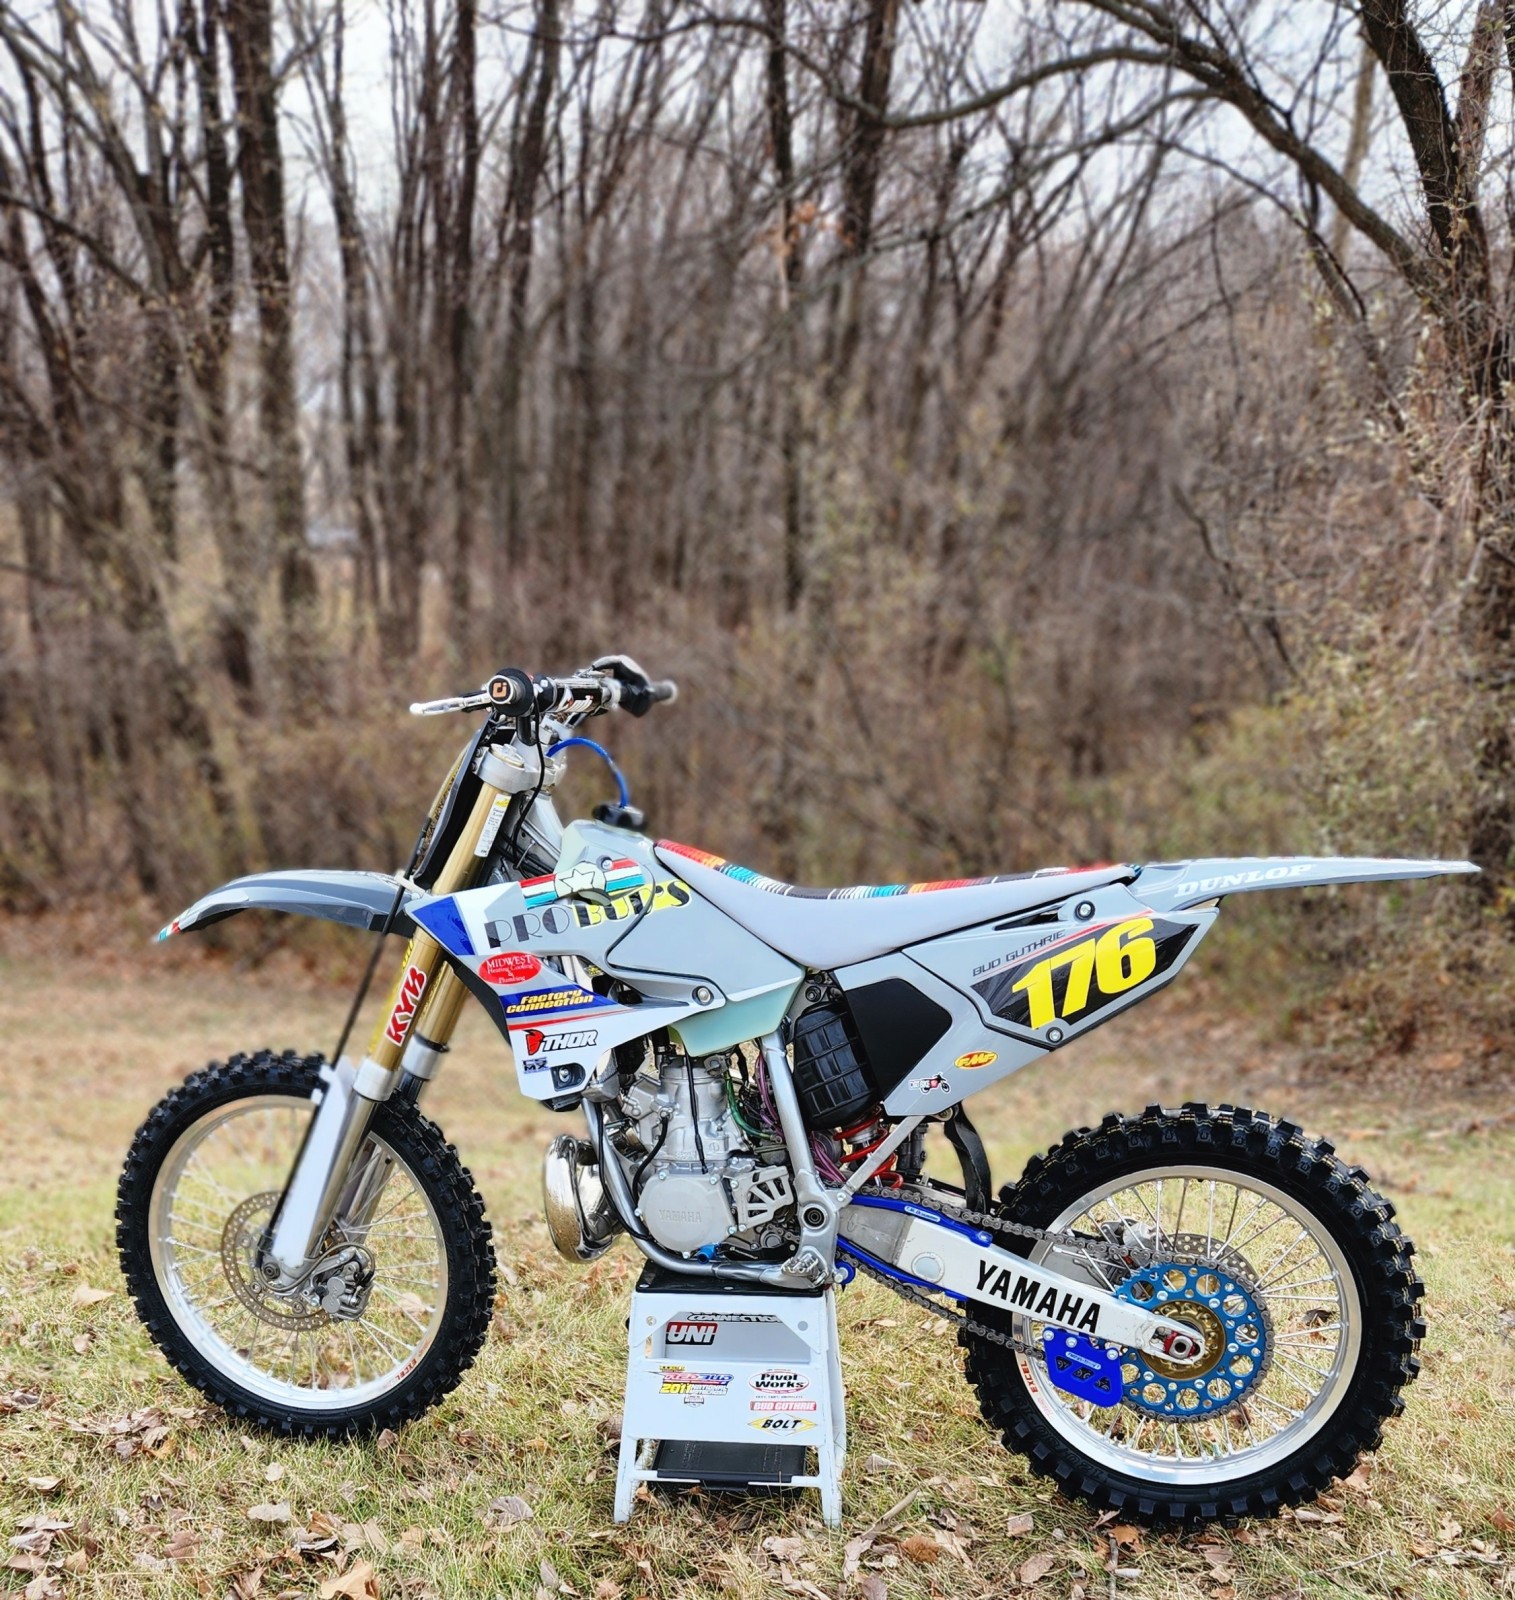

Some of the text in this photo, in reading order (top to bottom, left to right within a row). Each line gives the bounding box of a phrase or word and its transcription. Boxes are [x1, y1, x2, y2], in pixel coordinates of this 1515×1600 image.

[1174, 864, 1315, 898] DUNLOP
[486, 955, 531, 968] MIDWEST
[973, 929, 1066, 977] BUD GUTHRIE
[1012, 918, 1157, 1031] 176
[385, 966, 427, 1046] KYB
[542, 1030, 598, 1052] THOR
[658, 1209, 702, 1223] YAMAHA
[976, 1259, 1101, 1334] YAMAHA
[667, 1325, 716, 1343] UNI
[395, 1358, 417, 1380] EXCEL
[761, 1373, 798, 1381] Pivot
[1020, 1360, 1039, 1393] EXCEL
[660, 1383, 692, 1394] 2011
[754, 1402, 815, 1410] BUD GUTHRIE
[761, 1419, 802, 1429] BOLT
